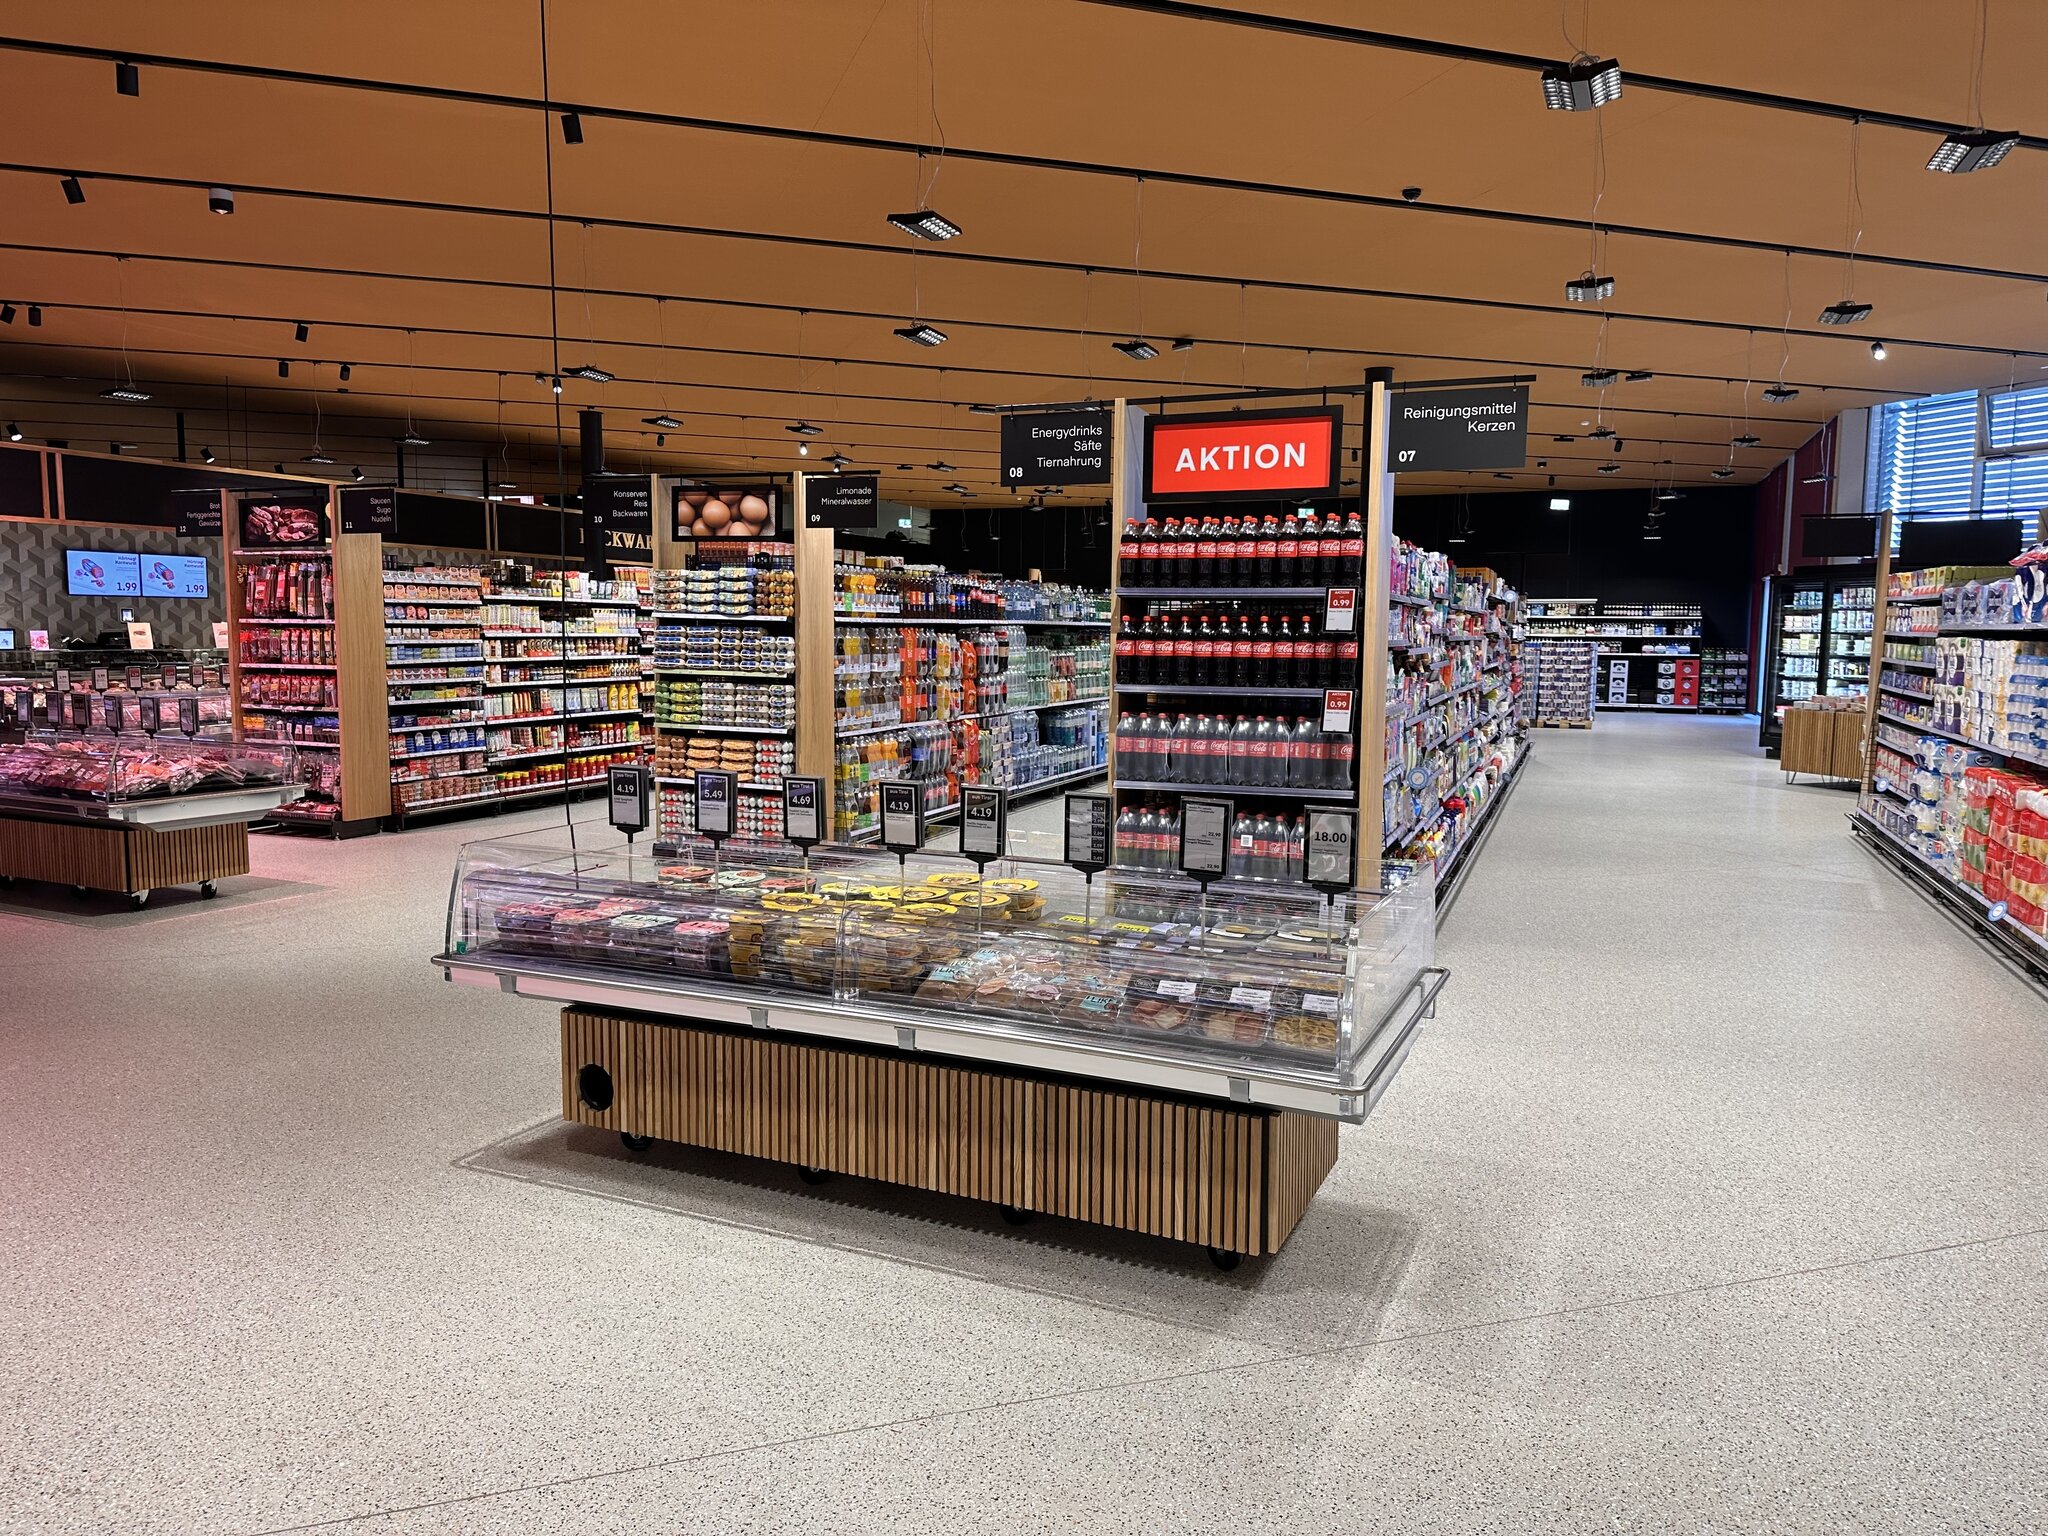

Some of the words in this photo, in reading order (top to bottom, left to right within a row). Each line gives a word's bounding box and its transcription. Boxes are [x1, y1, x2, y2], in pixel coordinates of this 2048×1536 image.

[1403, 402, 1517, 421] Reinigungsmittel
[1466, 420, 1516, 433] Kerzen
[1031, 425, 1103, 440] Energydrinks
[1073, 440, 1102, 452] Säfte
[1174, 442, 1306, 473] AKTION
[1398, 450, 1416, 463] 07
[1036, 456, 1102, 468] Tiernahrung
[1009, 467, 1023, 478] 08
[613, 490, 648, 498] Konserven
[836, 486, 872, 495] Limonade
[370, 497, 391, 505] Saucen
[633, 500, 648, 508] Reis
[821, 497, 872, 506] Mineralwasser
[376, 506, 392, 515] Sugo
[612, 509, 648, 517] Backwaren
[371, 515, 392, 523] Nudeln
[811, 514, 821, 522] 09
[345, 521, 353, 529] 11
[116, 582, 137, 591] 1.99
[185, 584, 204, 593] 1.99
[1330, 700, 1347, 708] 0.99
[616, 784, 635, 793] 4.19
[703, 790, 723, 799] 5.49
[792, 795, 811, 805] 4.69
[889, 801, 910, 811] 4.19
[970, 807, 993, 818] 4.19
[1314, 831, 1347, 844] 18.00
